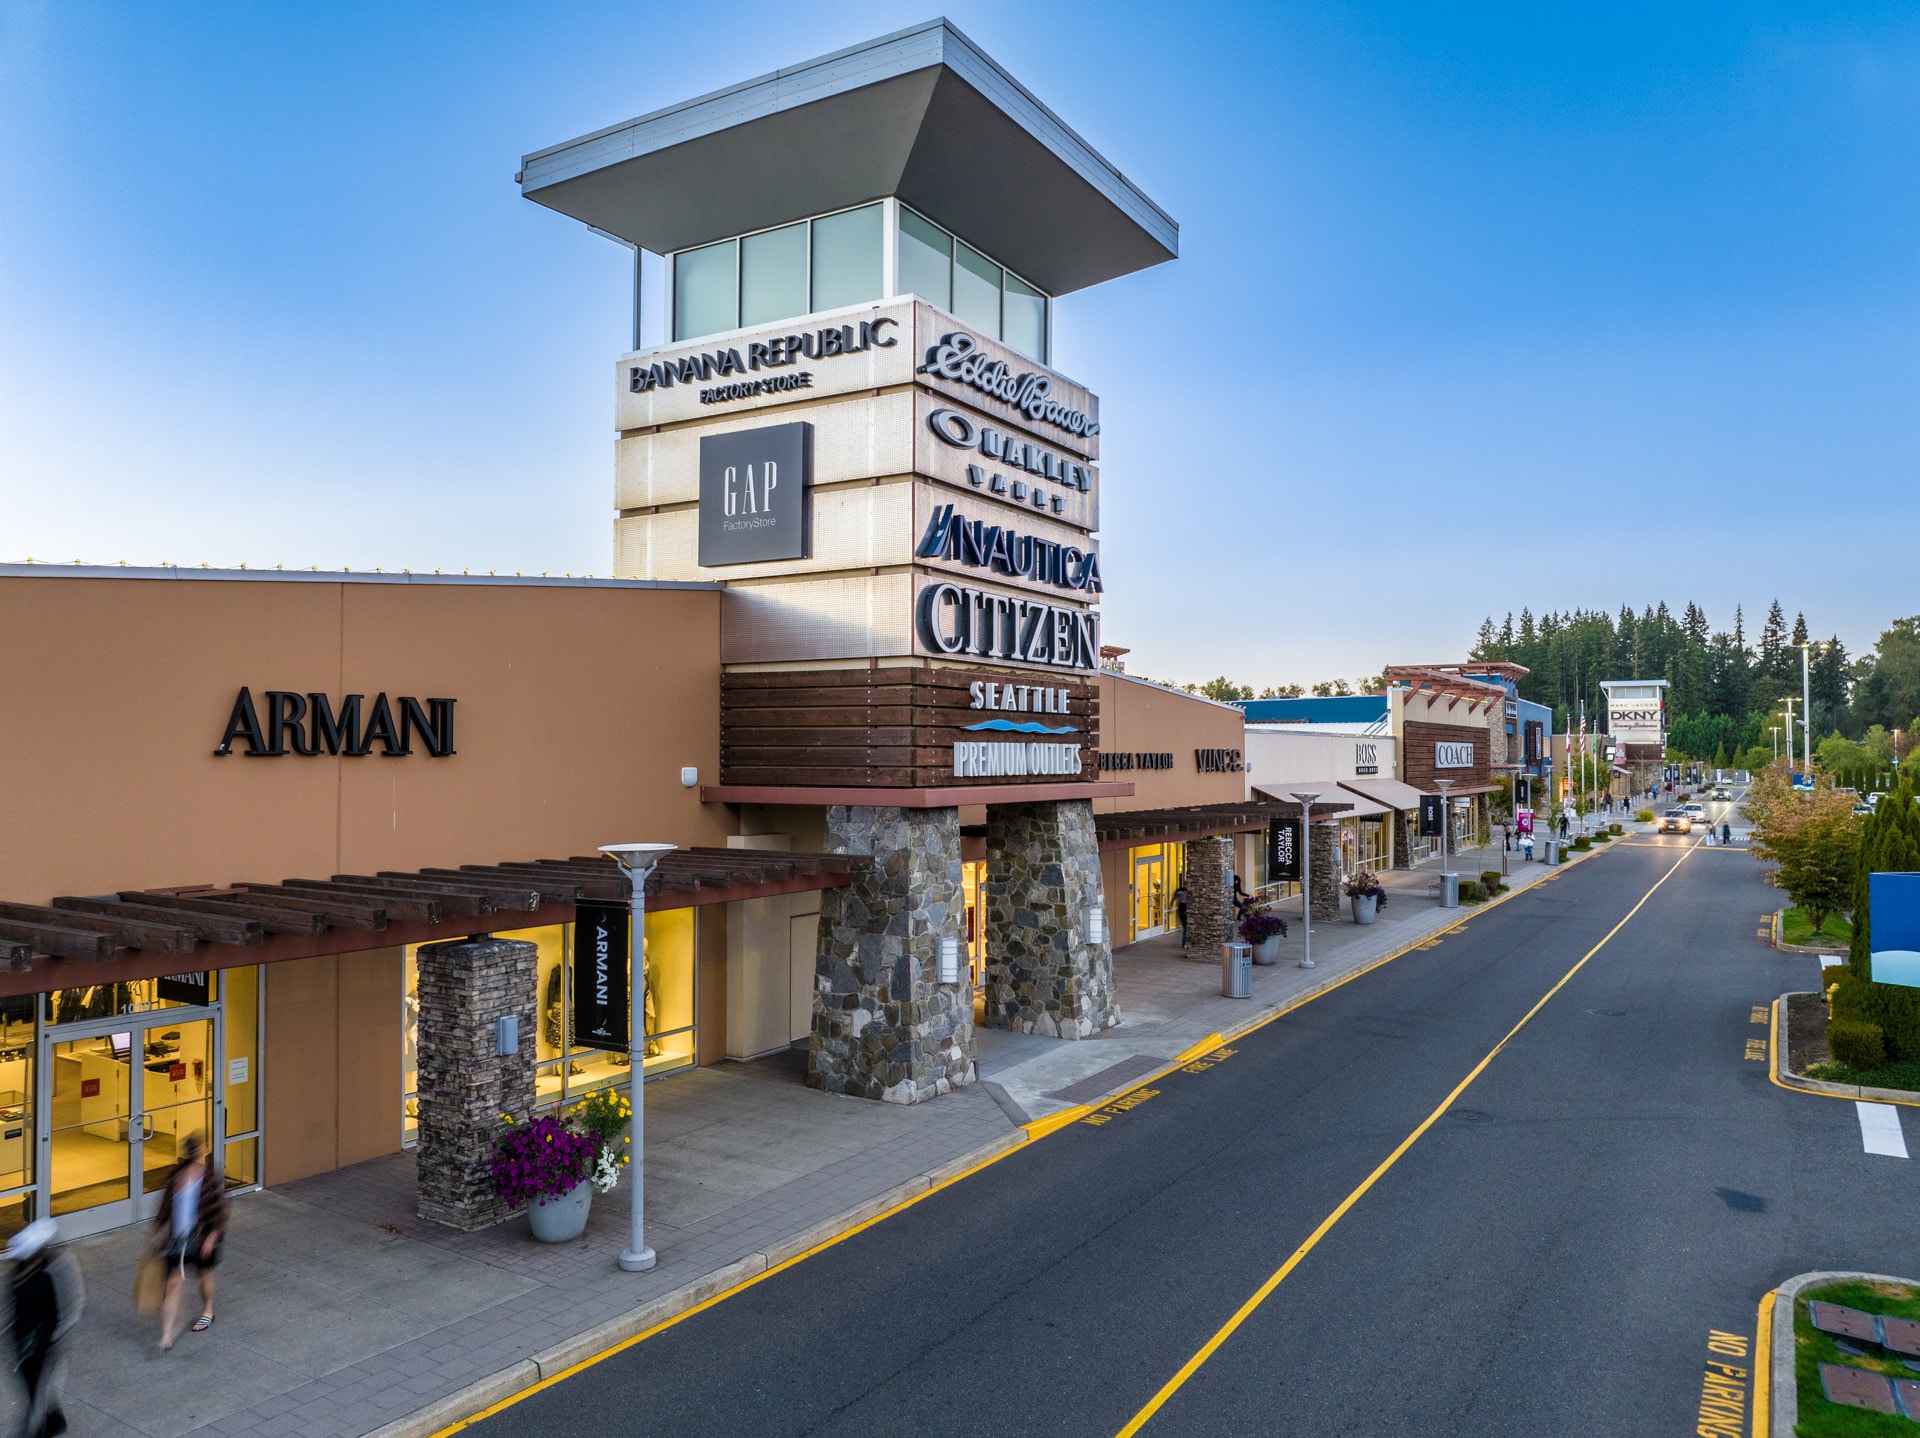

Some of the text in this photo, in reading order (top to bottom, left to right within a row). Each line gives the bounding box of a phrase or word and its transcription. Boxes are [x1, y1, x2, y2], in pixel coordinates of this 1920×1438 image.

[629, 317, 899, 393] BANANA REPUBLIC
[700, 371, 813, 404] FACTORY STORE
[918, 332, 1101, 437] Eddie Bauer
[724, 461, 777, 517] GAP
[968, 463, 1065, 514] VAULT
[951, 514, 1105, 594] NAUTICA
[922, 582, 1100, 669] CITIZEN
[969, 680, 1071, 714] SEATTLE
[1610, 711, 1658, 720] DKNY
[213, 686, 458, 757] ARMANI
[954, 741, 1082, 777] PREMIUM OUTLETS
[1135, 753, 1174, 770] TAYLOR
[1355, 743, 1377, 764] BOSS
[1438, 745, 1473, 765] COACH
[1277, 829, 1285, 863] TAYLOR
[1285, 826, 1293, 866] REBECCA
[596, 925, 608, 1006] ARMANI
[1080, 1088, 1162, 1126] NO PARKING
[1696, 1329, 1749, 1438] NO PARKING
